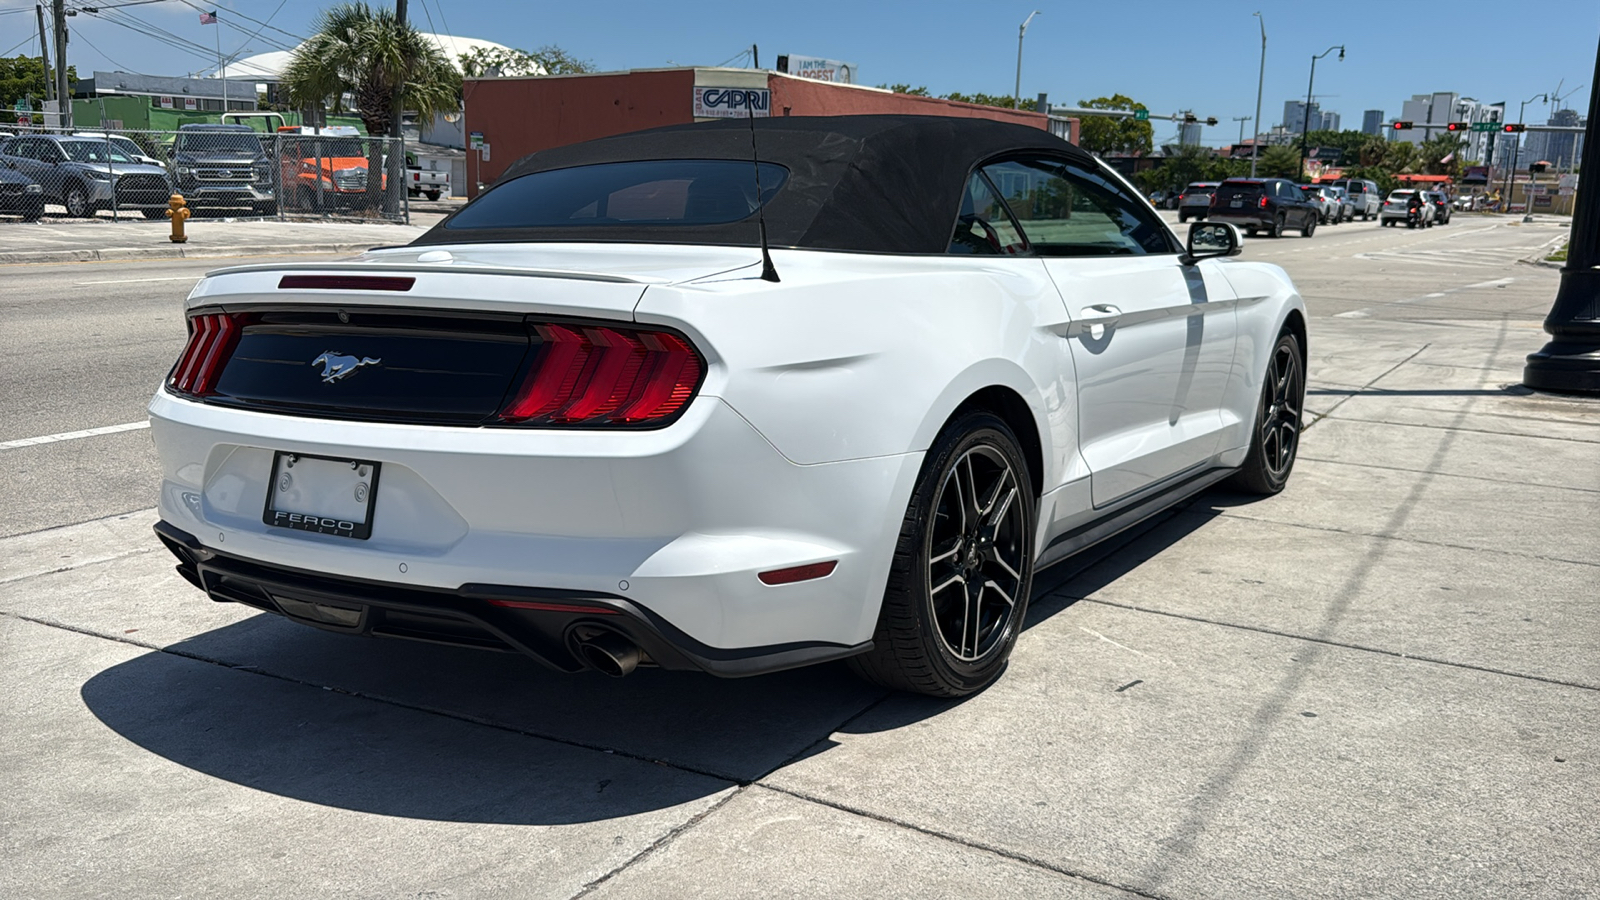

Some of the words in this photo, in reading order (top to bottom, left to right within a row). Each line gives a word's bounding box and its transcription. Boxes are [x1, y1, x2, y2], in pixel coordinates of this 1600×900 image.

[803, 60, 813, 69] AM
[814, 60, 827, 69] THE
[703, 89, 768, 110] CAPRI
[273, 520, 354, 538] MOTORS
[275, 511, 355, 531] FERCO
